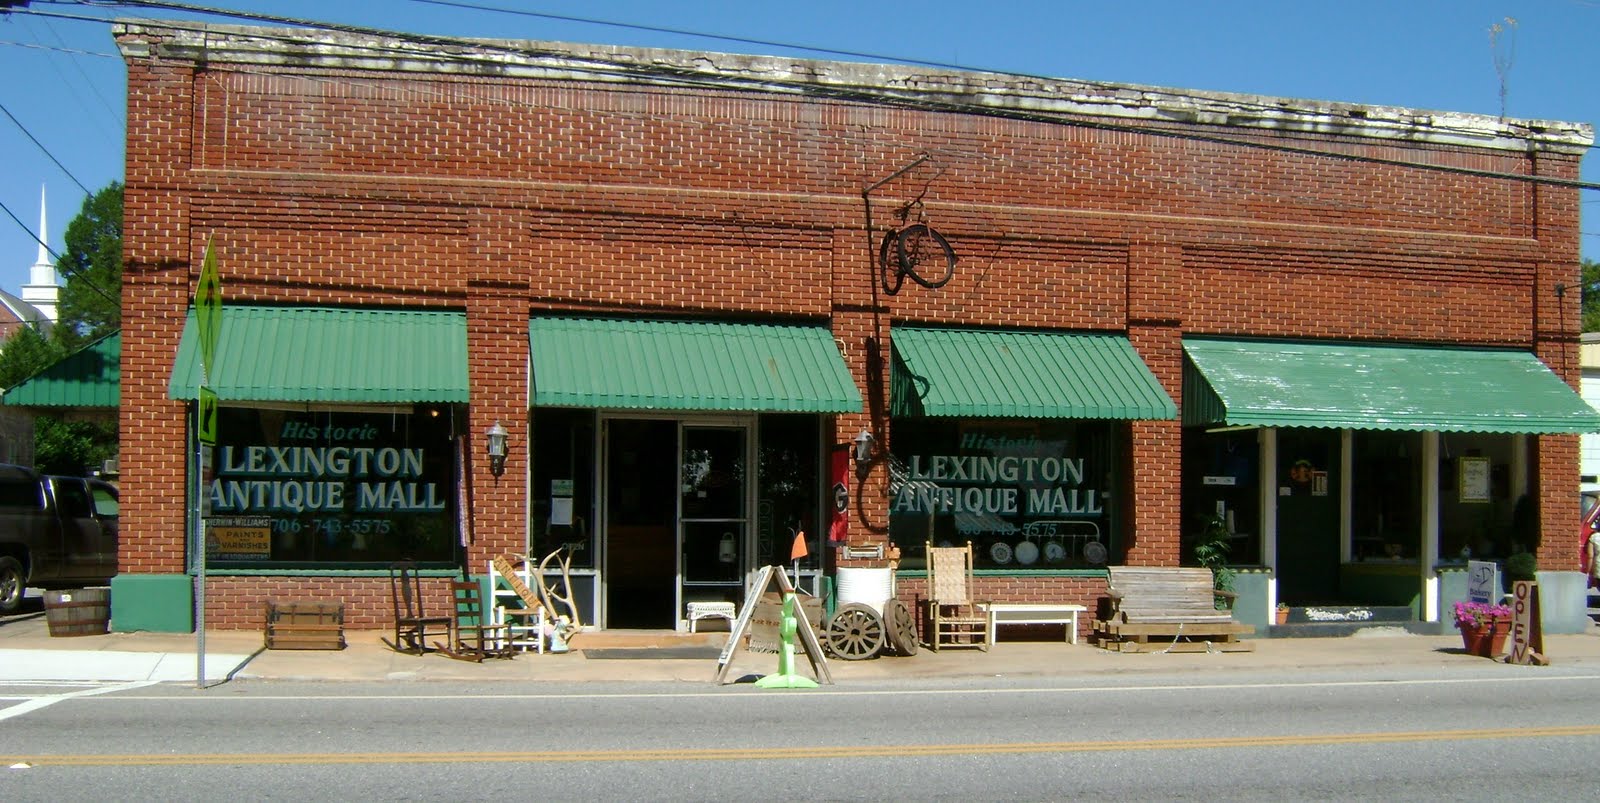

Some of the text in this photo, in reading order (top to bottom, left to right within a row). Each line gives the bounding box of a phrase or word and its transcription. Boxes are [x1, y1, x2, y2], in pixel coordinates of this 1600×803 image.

[281, 420, 378, 440] Historic
[222, 445, 425, 477] LEXINGTON
[911, 454, 1085, 485] LEXINGTON
[209, 478, 446, 513] ANTIQUE MALL
[893, 486, 1103, 516] ANTIQUE MALL
[226, 531, 265, 539] PAINTS
[271, 518, 391, 534] 706-743-5575
[1511, 582, 1528, 662] OPEN
